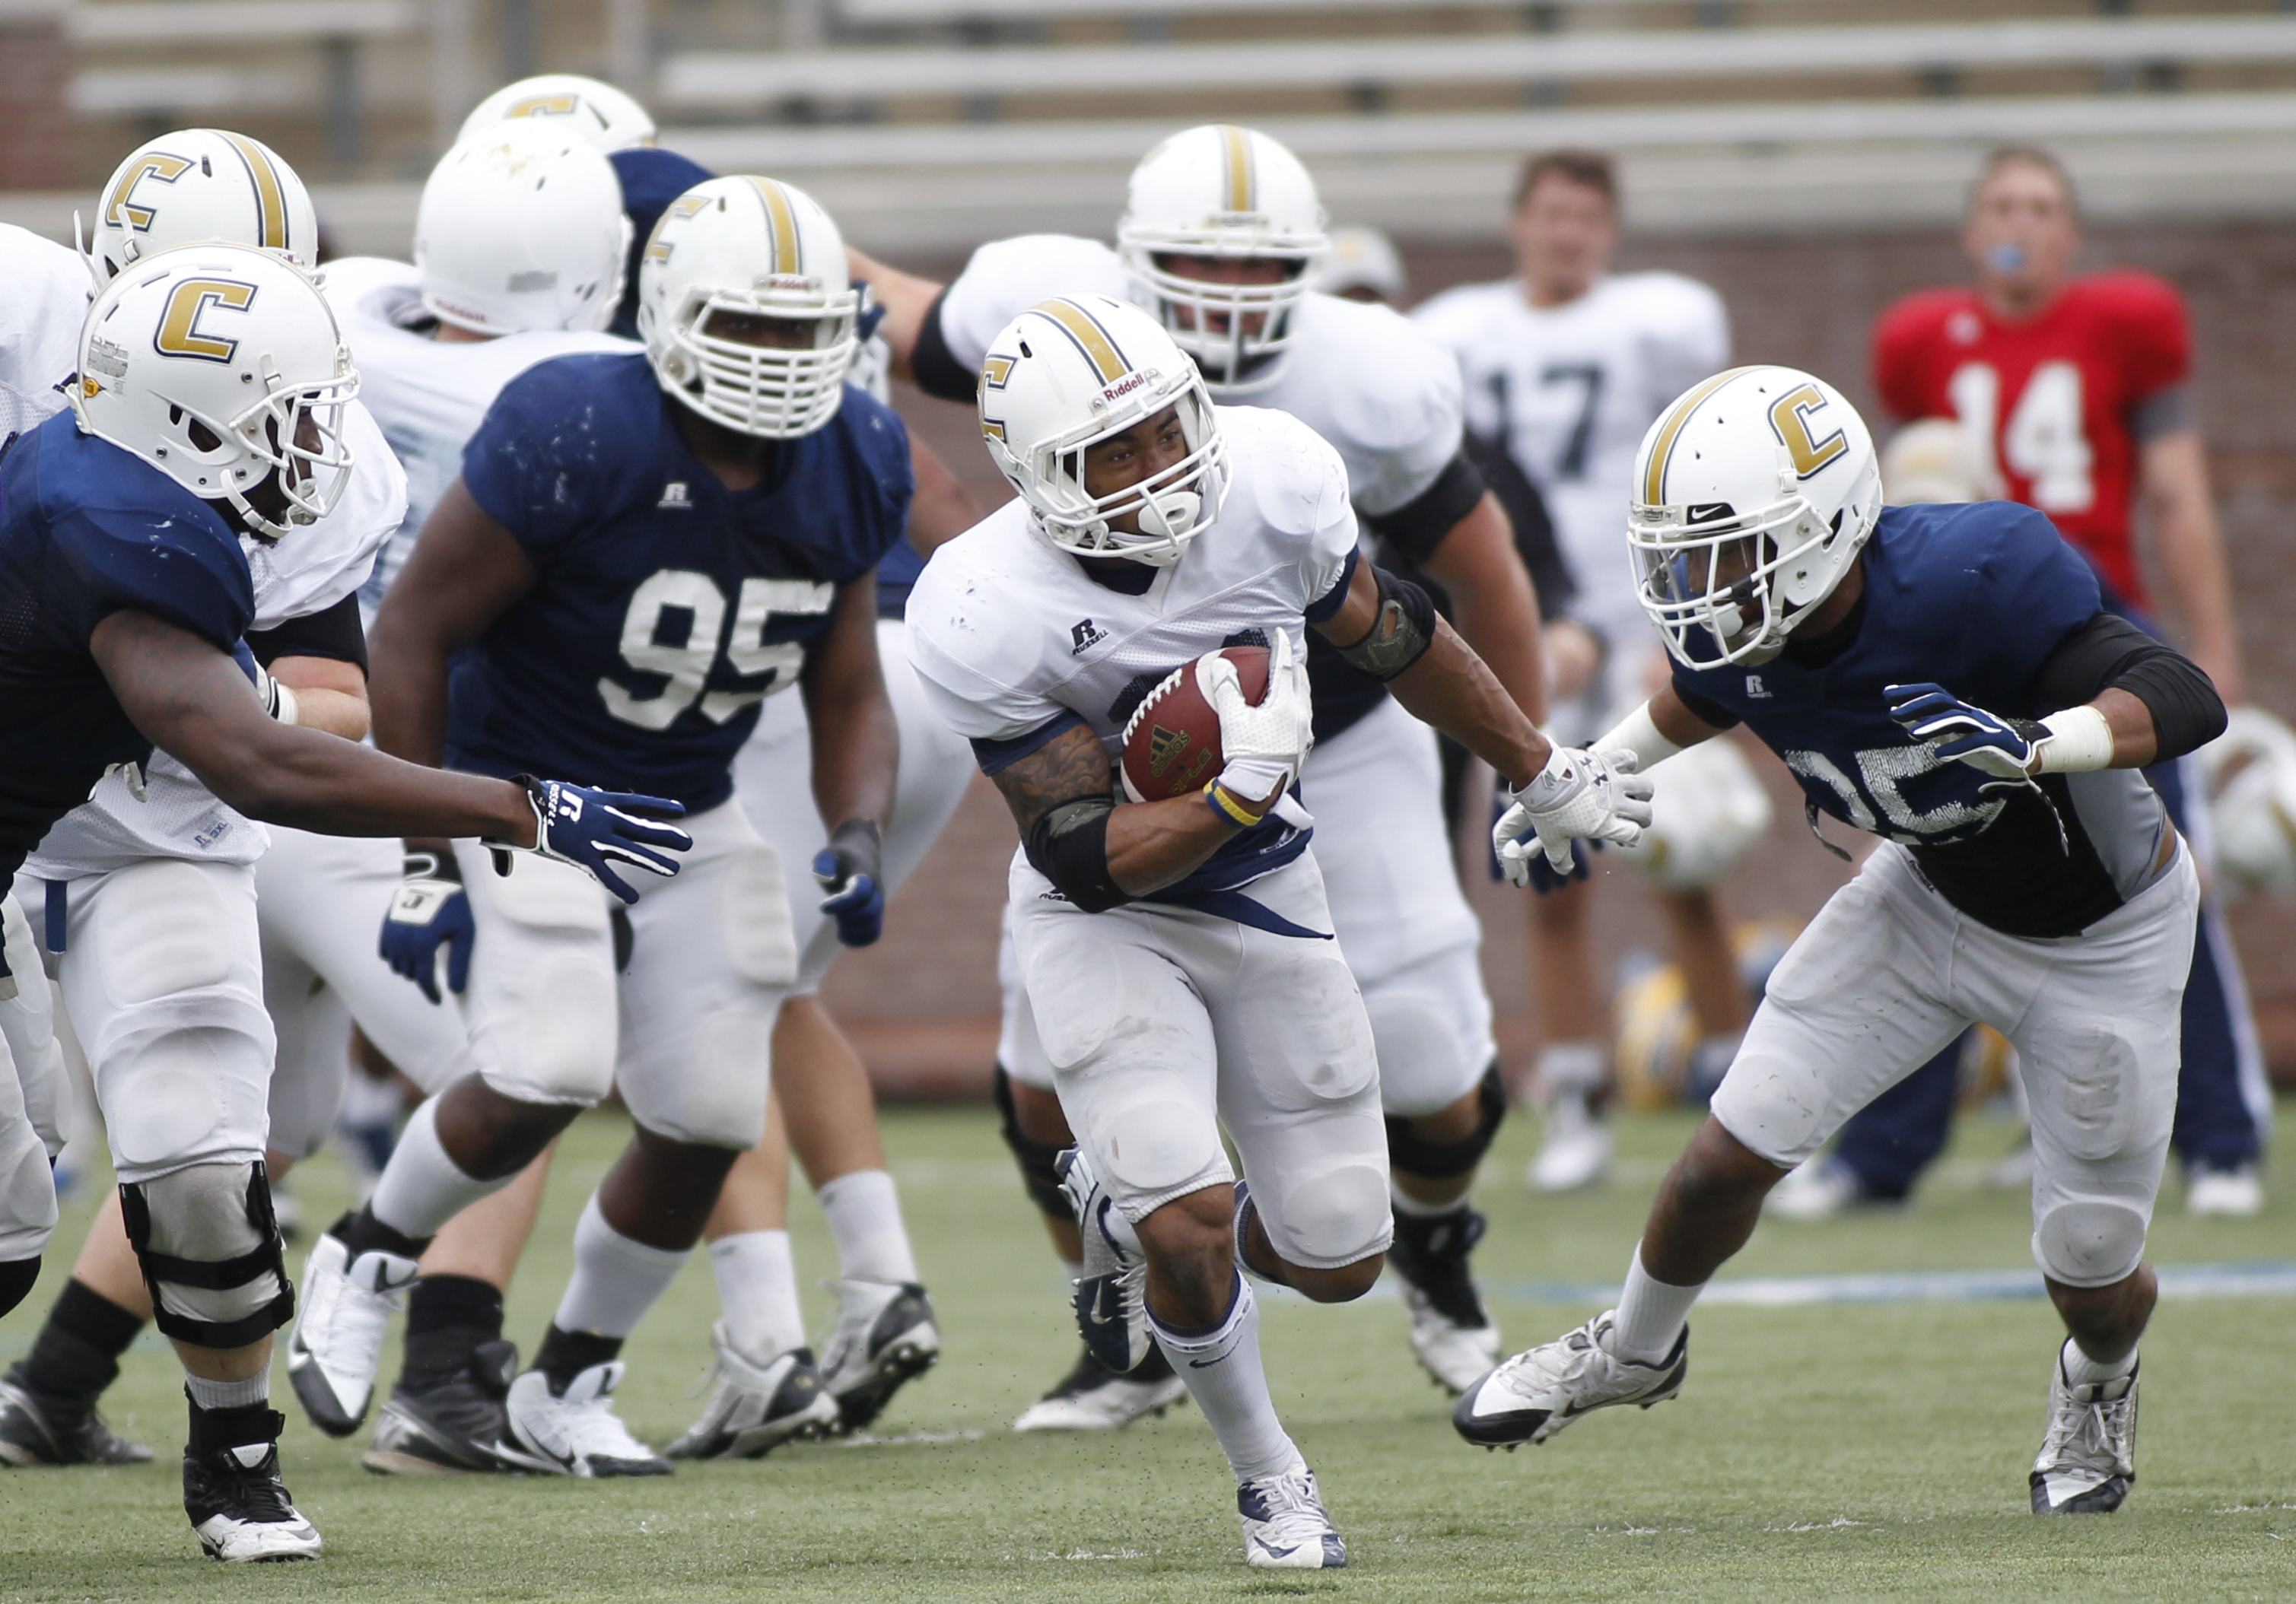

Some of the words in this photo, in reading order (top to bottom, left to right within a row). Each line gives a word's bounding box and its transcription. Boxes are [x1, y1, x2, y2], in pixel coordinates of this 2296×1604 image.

[105, 151, 196, 232] C
[153, 277, 259, 364] C
[1103, 373, 1144, 402] Riddell
[1767, 383, 1849, 481] C
[1945, 360, 2096, 513] 14
[597, 569, 834, 731] 95
[1071, 618, 1096, 647] R
[1073, 629, 1109, 656] RUSSELL
[1746, 675, 1763, 693] R
[1151, 729, 1191, 777] adidas
